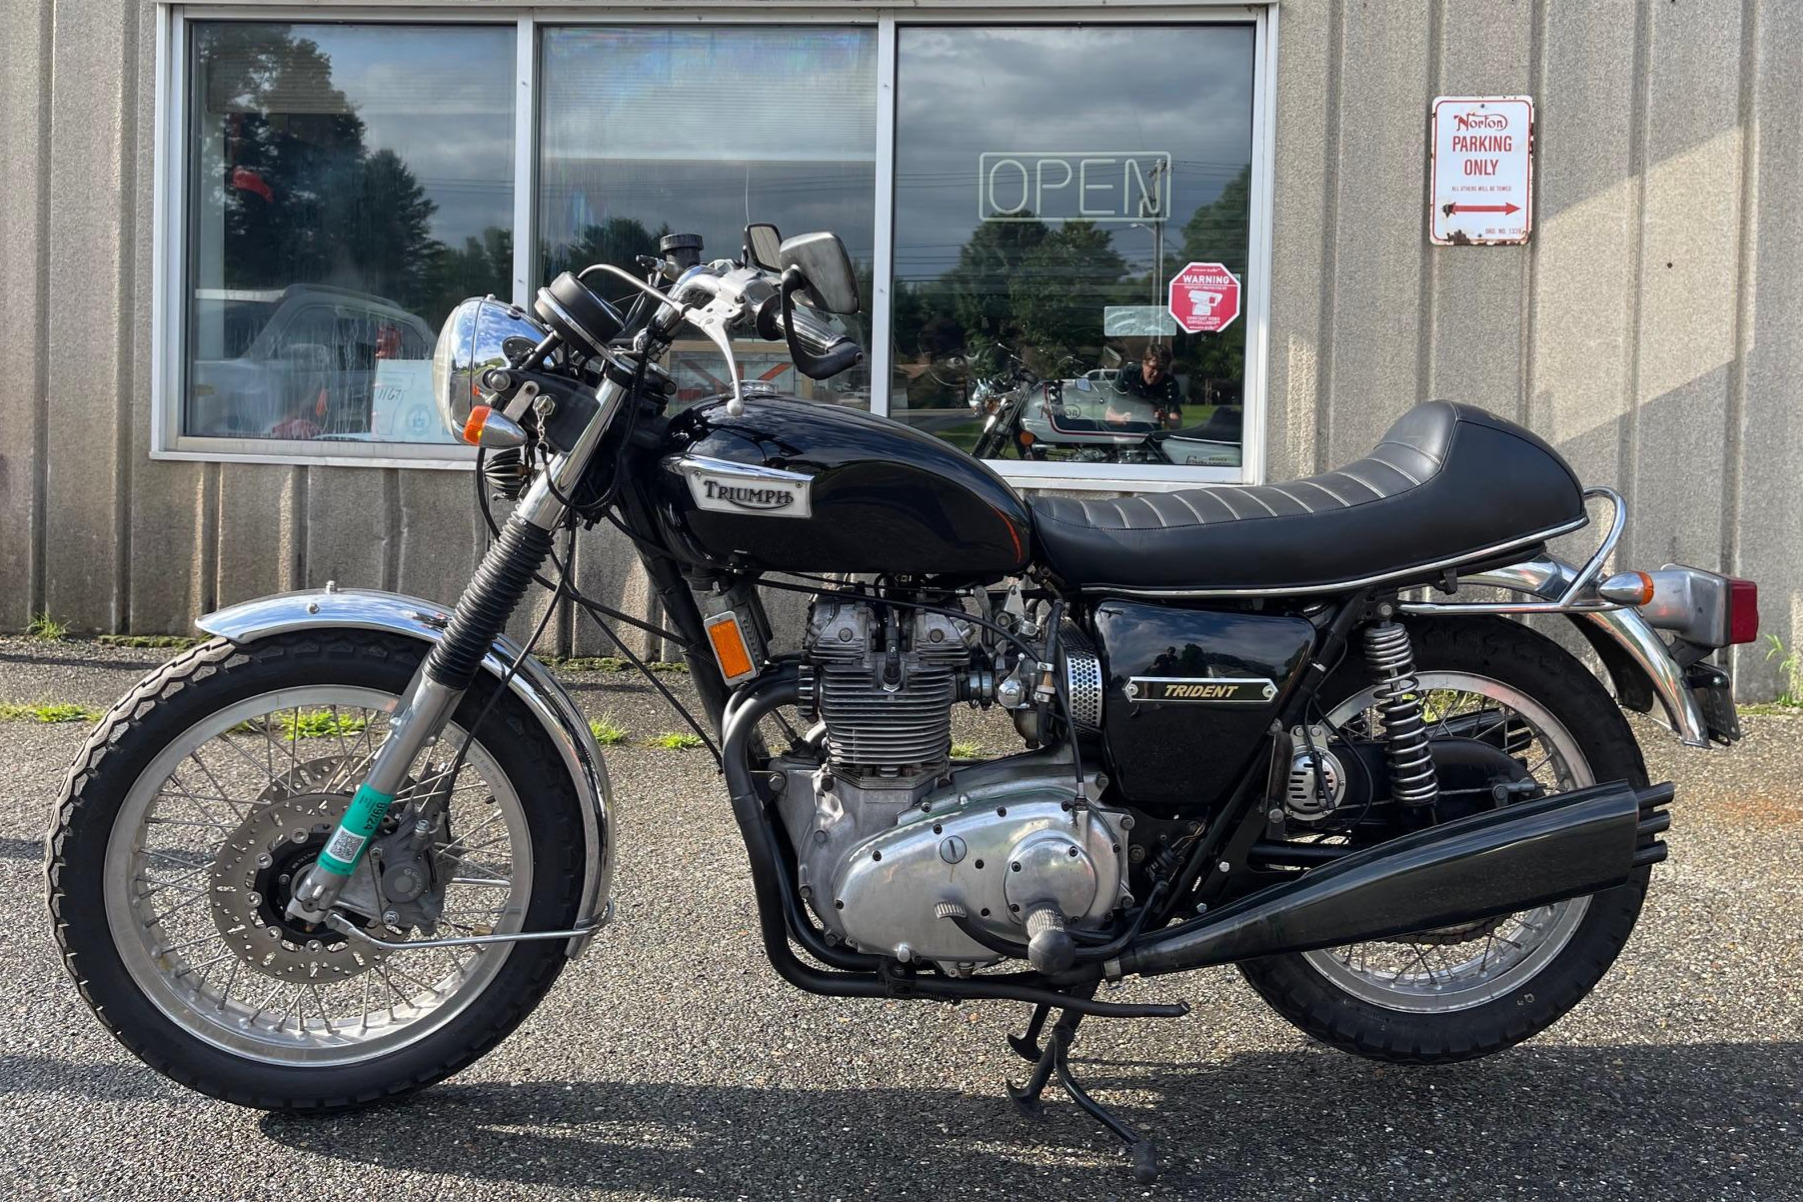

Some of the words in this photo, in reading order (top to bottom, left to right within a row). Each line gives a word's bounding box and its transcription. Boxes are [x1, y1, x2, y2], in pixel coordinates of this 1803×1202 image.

[1453, 112, 1508, 132] Norton
[1452, 135, 1512, 152] PARKING
[1464, 159, 1499, 176] ONLY
[988, 158, 1161, 215] OPEN
[1182, 274, 1230, 285] WARNING
[703, 480, 794, 510] TRIUMPH
[1164, 684, 1239, 698] TRIDENT
